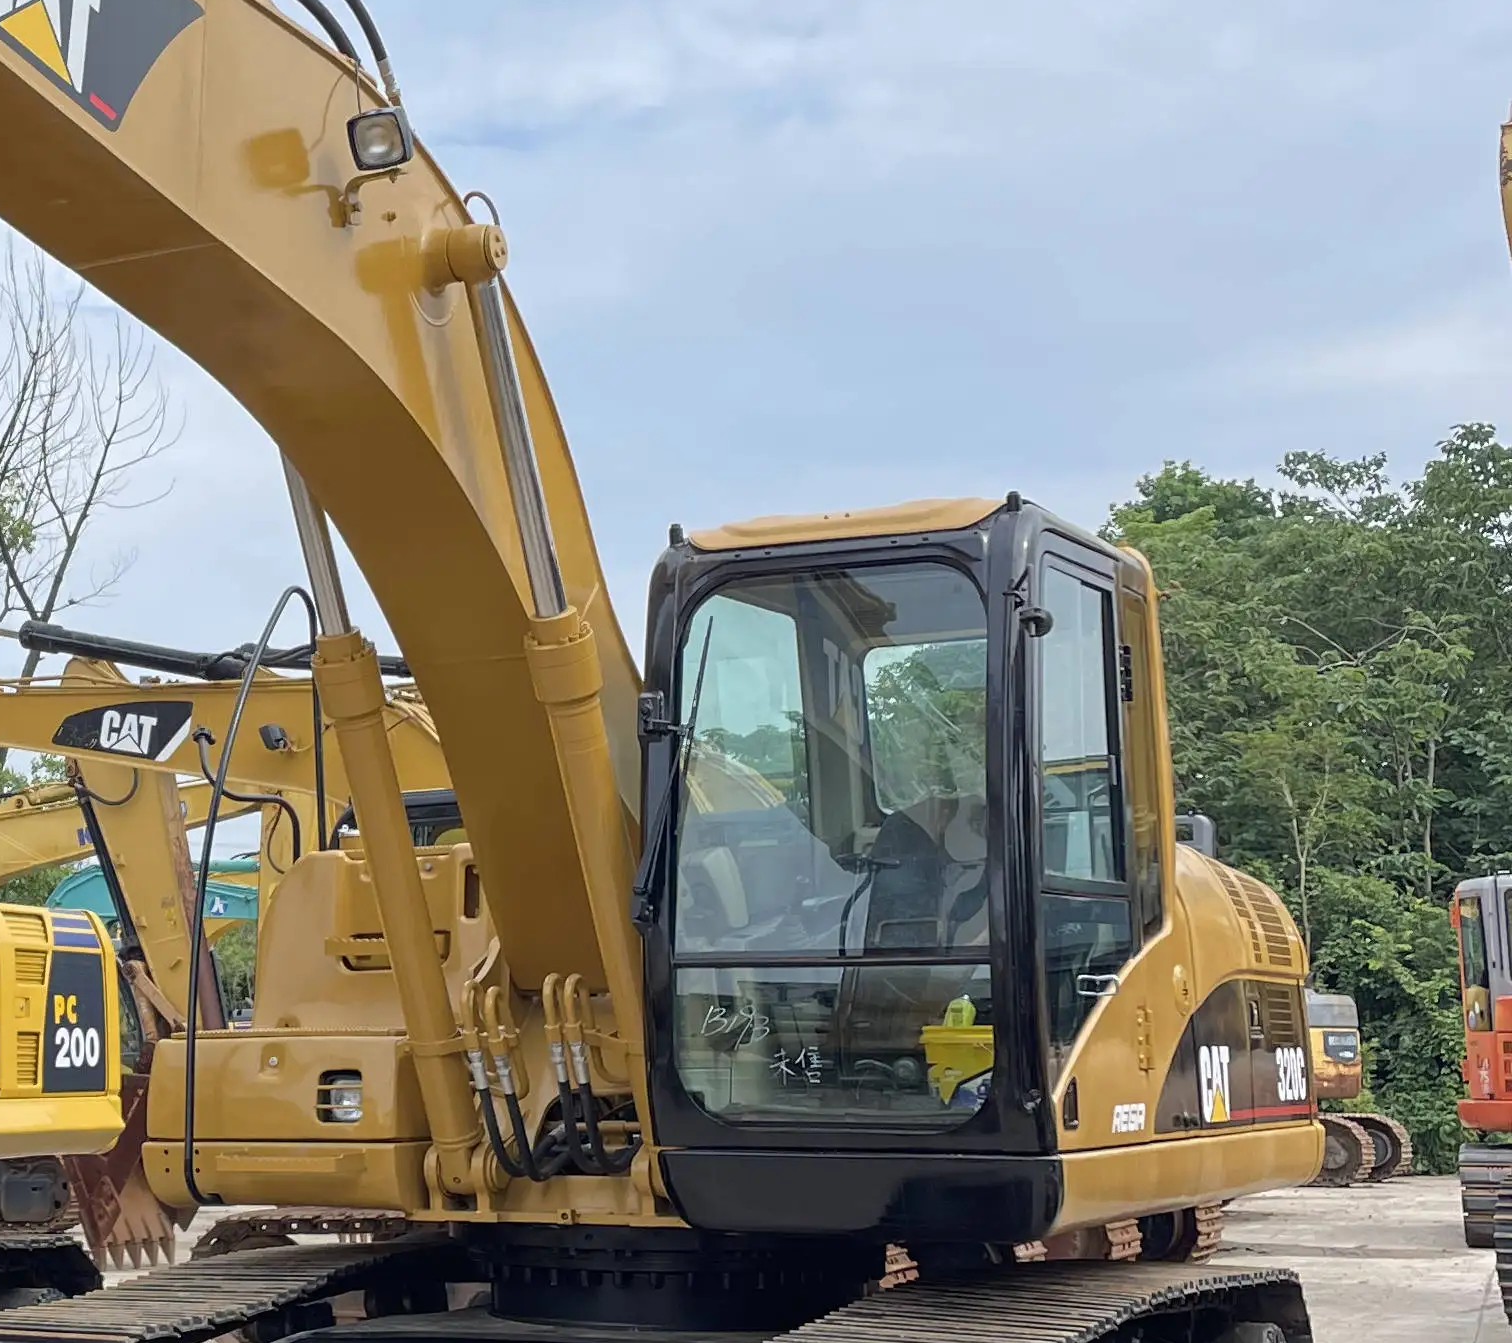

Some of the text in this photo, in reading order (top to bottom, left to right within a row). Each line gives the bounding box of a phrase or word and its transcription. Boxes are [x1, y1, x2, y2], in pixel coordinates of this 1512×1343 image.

[99, 710, 158, 755] CAT
[54, 994, 77, 1025] PC
[55, 1027, 100, 1067] 200
[1199, 1045, 1231, 1123] CAT
[1275, 1046, 1307, 1101] 320C
